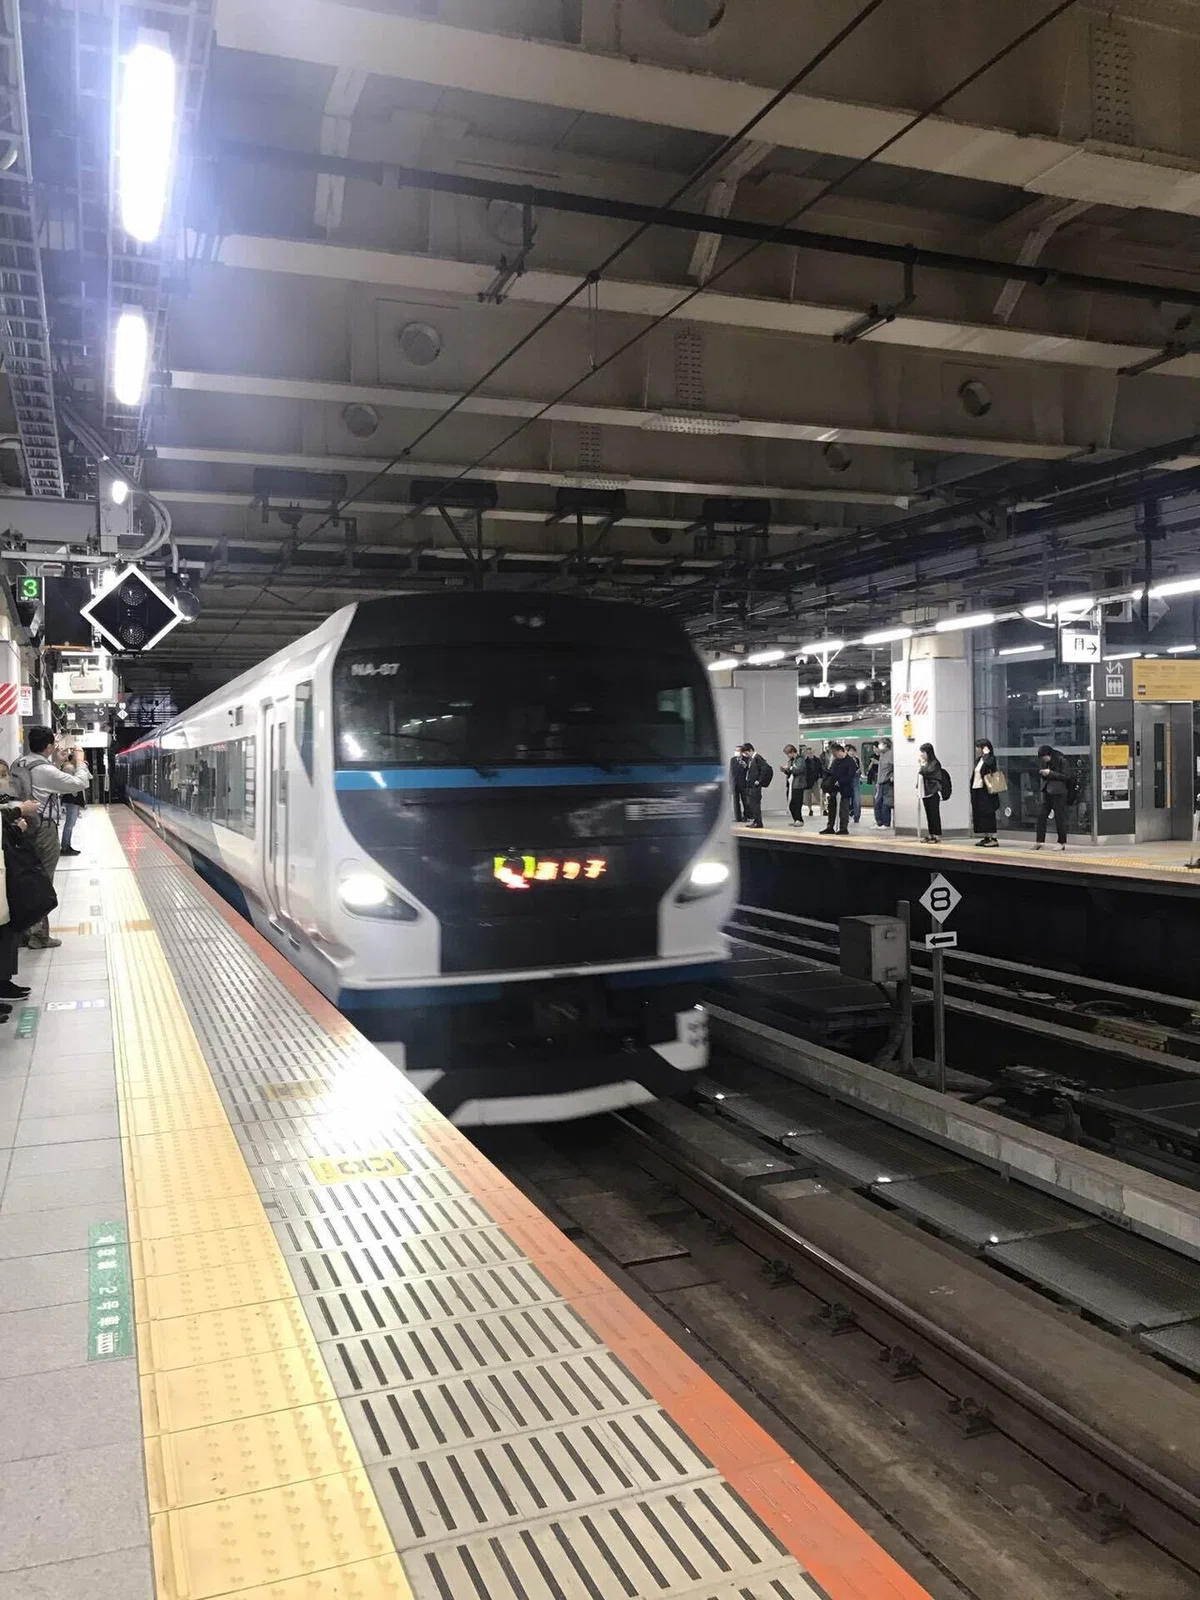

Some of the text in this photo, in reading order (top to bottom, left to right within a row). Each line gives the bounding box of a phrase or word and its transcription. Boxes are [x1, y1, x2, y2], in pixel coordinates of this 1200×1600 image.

[23, 579, 38, 597] 3
[99, 707, 105, 716] 5
[930, 887, 951, 911] 8
